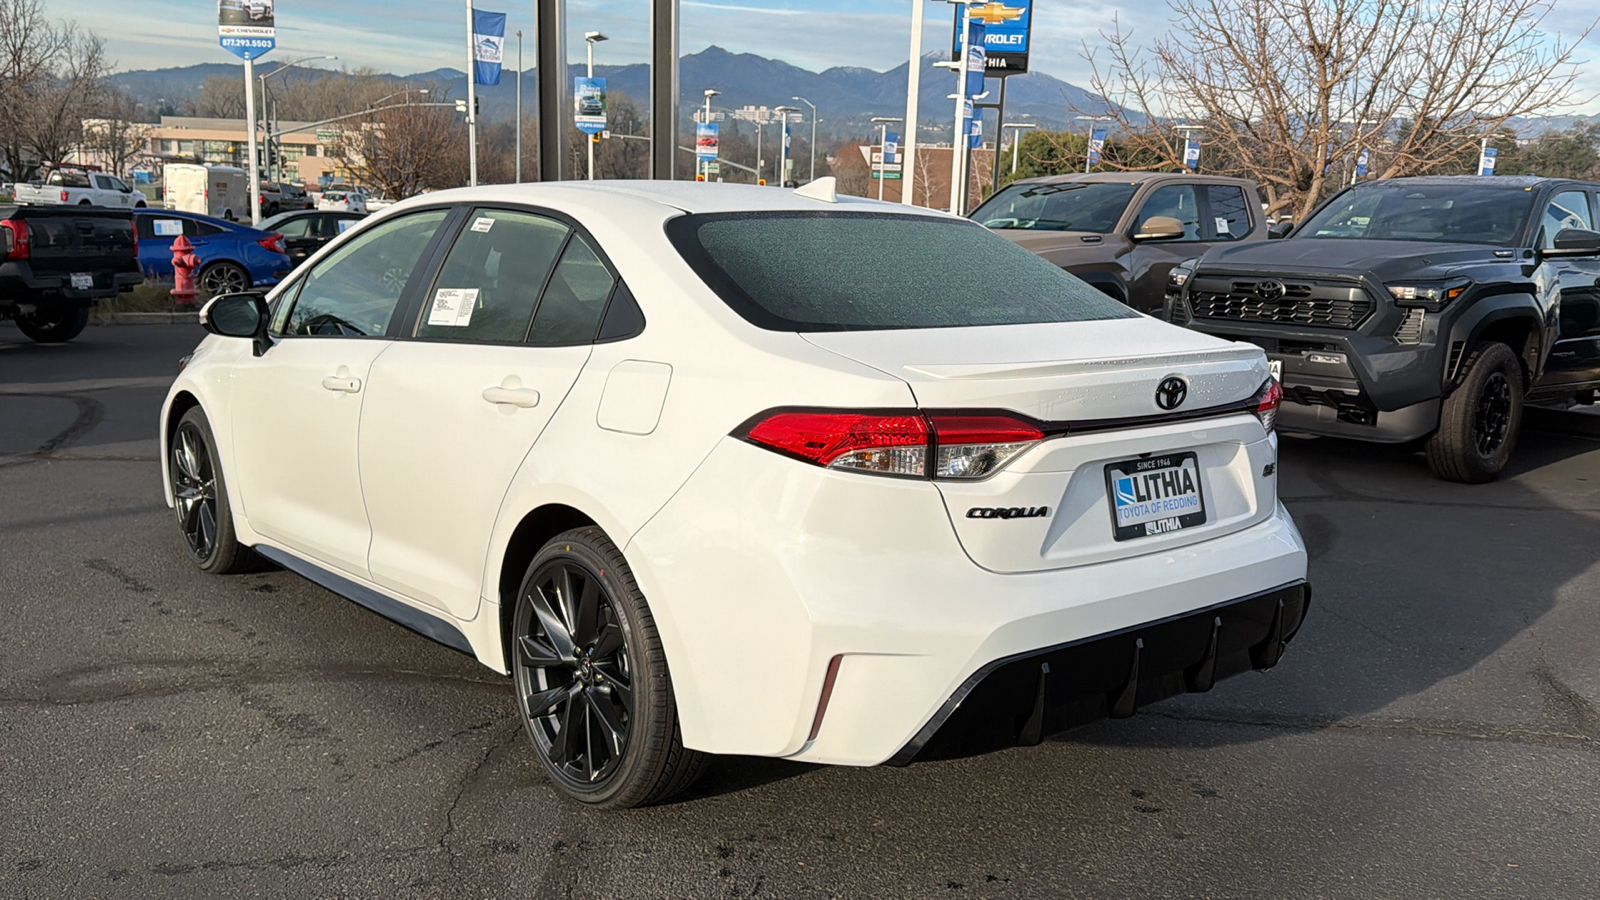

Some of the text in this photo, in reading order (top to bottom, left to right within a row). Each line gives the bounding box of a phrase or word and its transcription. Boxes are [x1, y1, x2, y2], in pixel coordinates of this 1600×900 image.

[959, 33, 1024, 44] CVROLET
[1136, 457, 1171, 470] SINCE 1946
[1132, 468, 1196, 503] LITHIA
[965, 505, 1048, 520] COROLLA
[1118, 495, 1198, 519] TOYOTA OF REDDING
[1153, 516, 1182, 534] LITHIA
